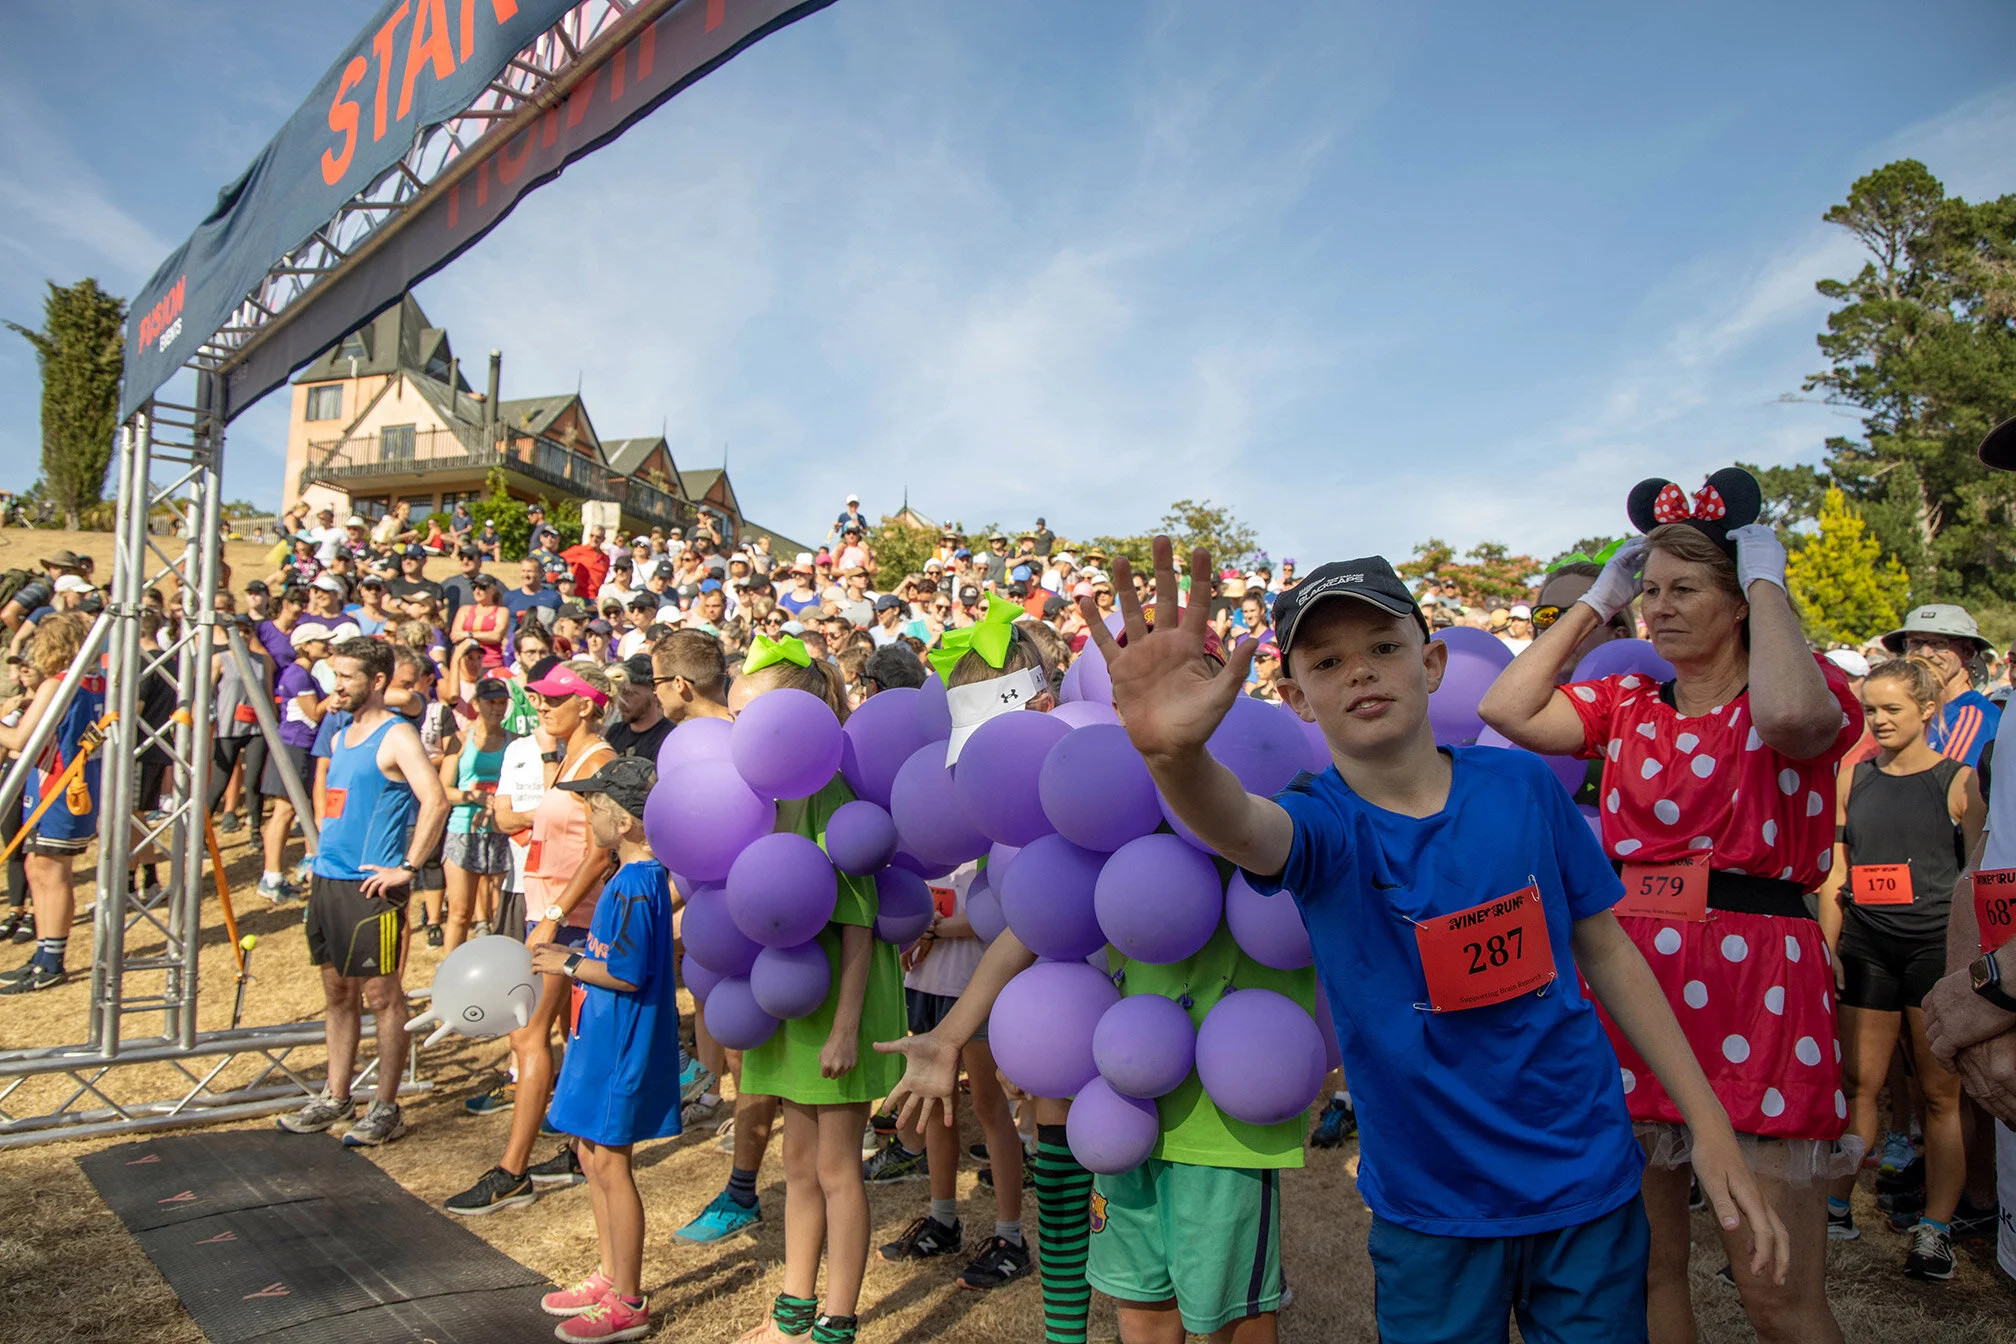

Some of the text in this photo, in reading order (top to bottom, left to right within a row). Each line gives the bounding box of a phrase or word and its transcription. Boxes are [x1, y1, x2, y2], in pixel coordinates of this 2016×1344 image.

[138, 274, 187, 355] FUSION
[1298, 576, 1364, 607] BLACKCAPS
[1640, 875, 1685, 897] 579
[1867, 877, 1897, 891] 170
[1448, 895, 1524, 930] VINE RUN
[1462, 926, 1523, 975] 287
[1460, 973, 1542, 1004] Supporting Brain Research
